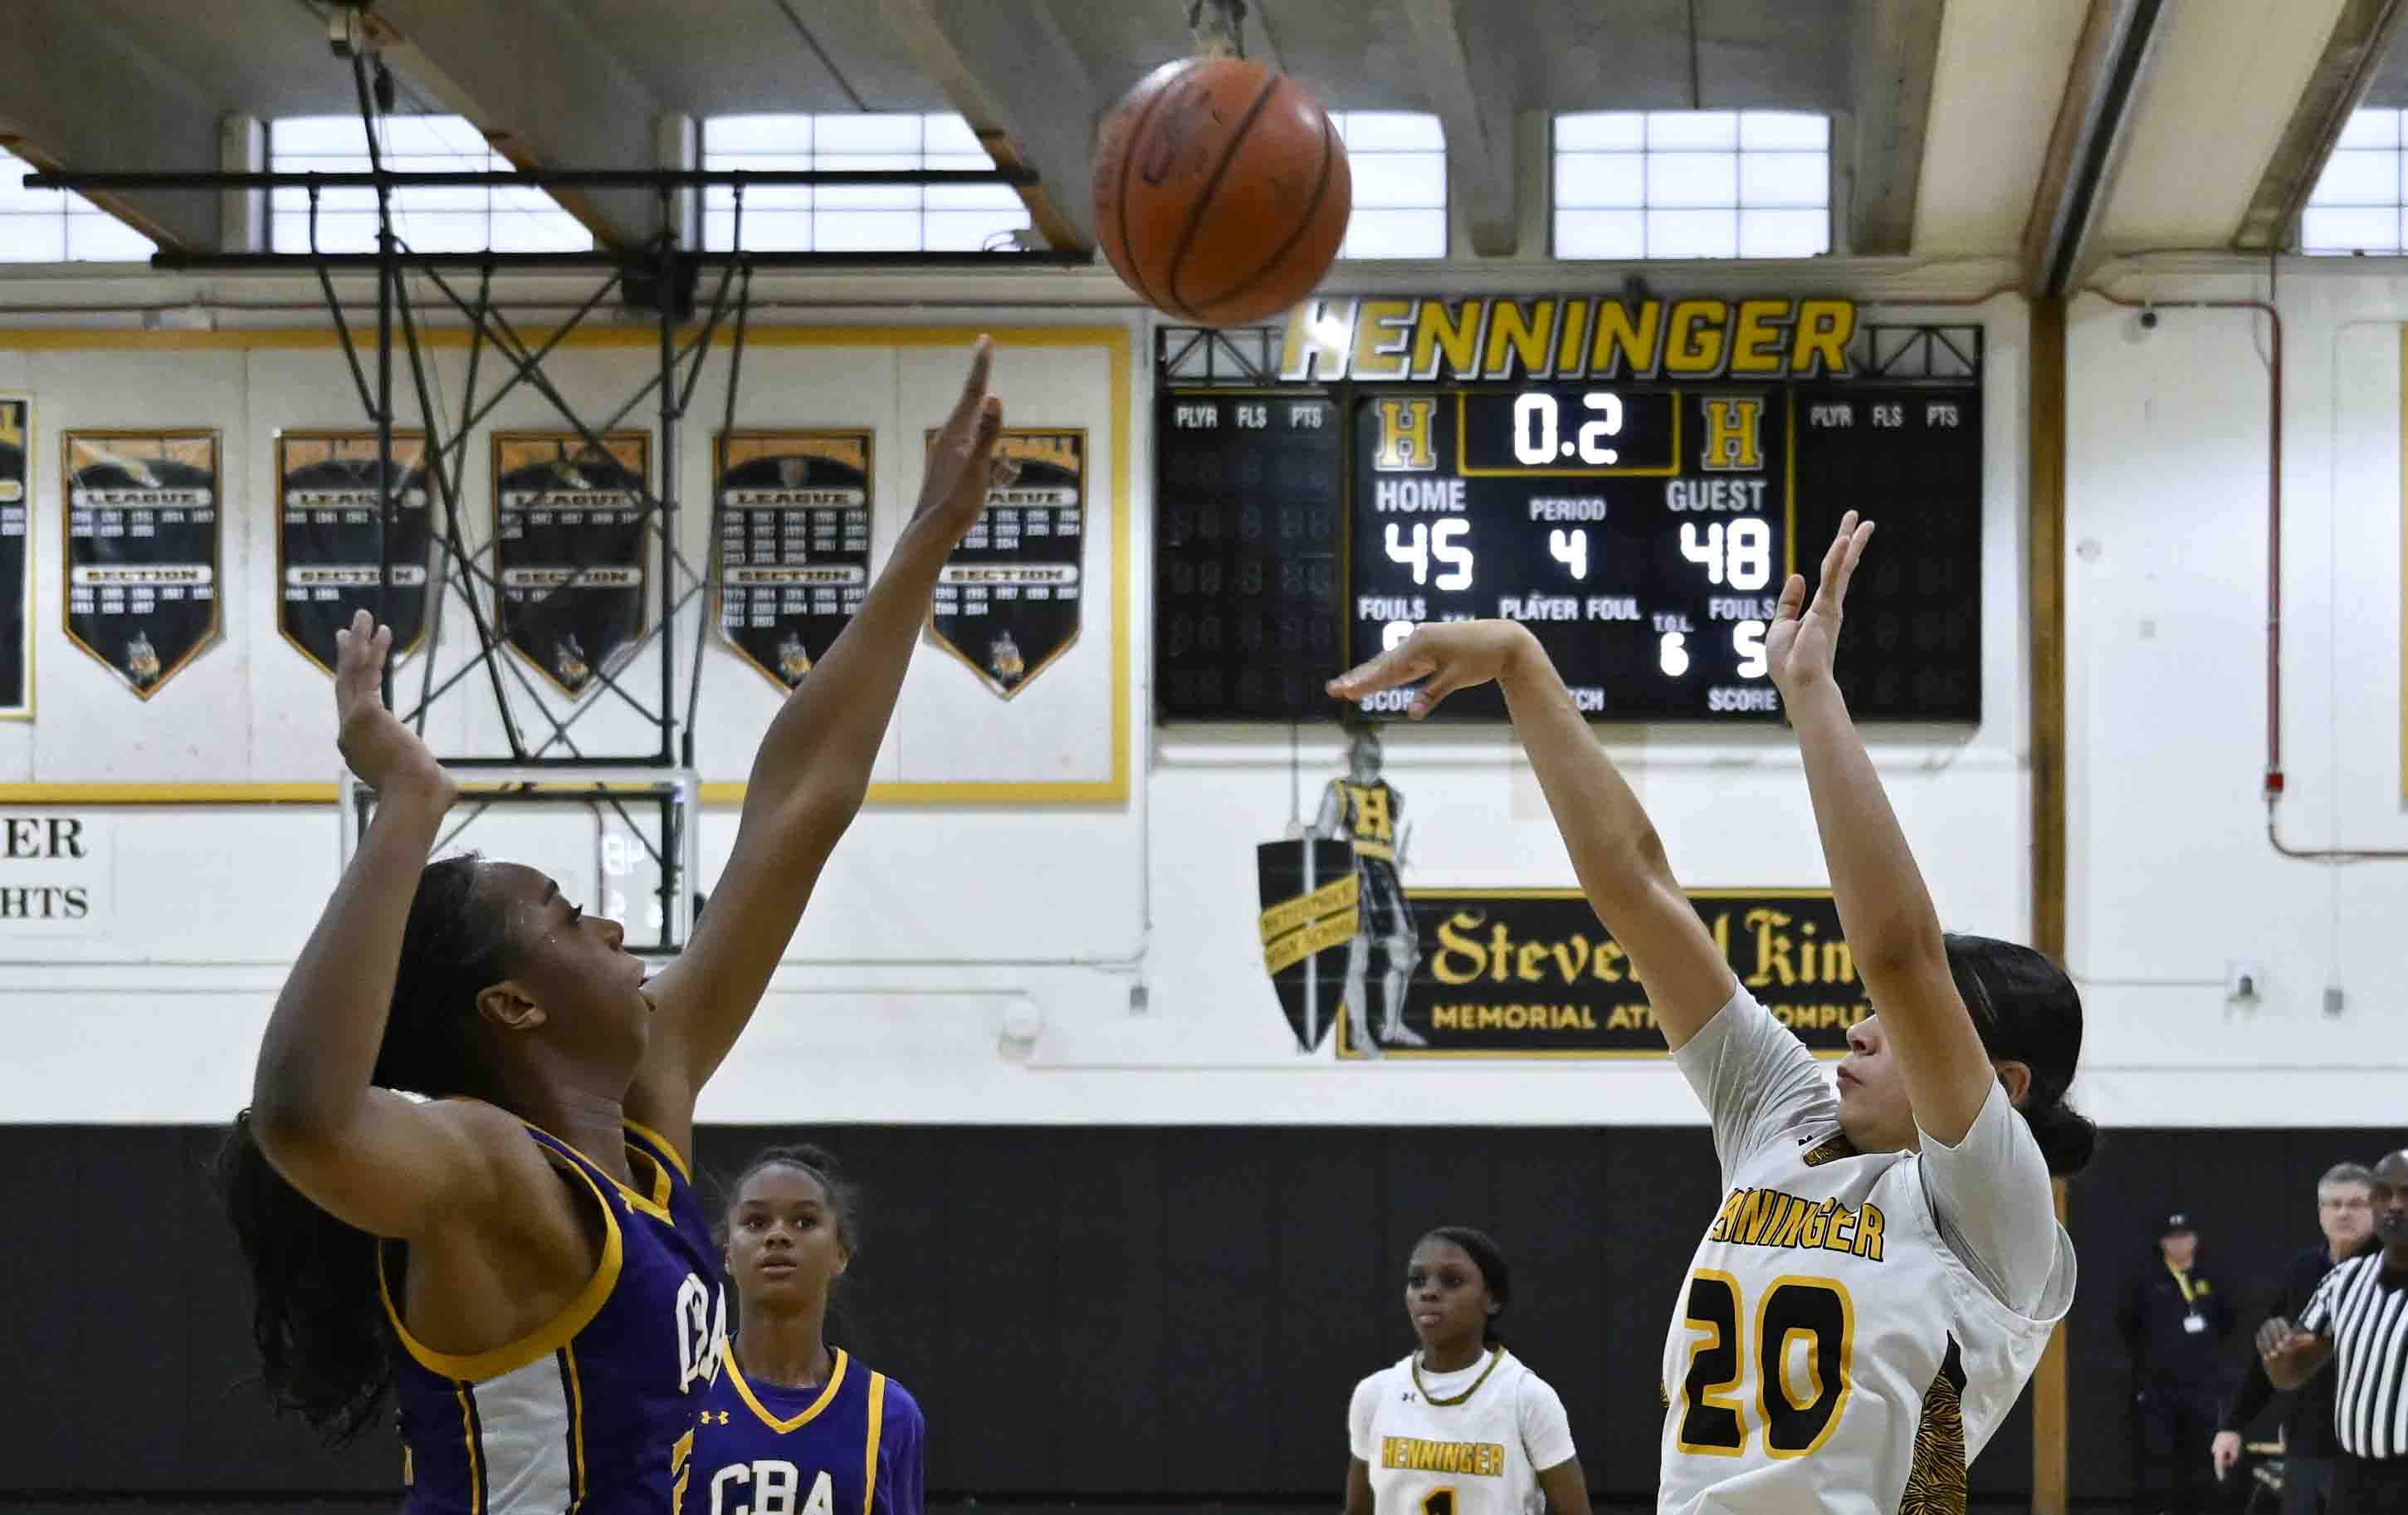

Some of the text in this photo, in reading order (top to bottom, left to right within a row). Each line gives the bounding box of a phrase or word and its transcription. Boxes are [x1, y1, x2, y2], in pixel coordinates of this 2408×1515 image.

[1279, 298, 1859, 380] HENNINGER
[1177, 405, 1322, 428] PLYR FLS PTS
[1375, 398, 1437, 471] H
[1514, 393, 1624, 465] 0.2
[1702, 398, 1762, 471] H
[1811, 405, 1959, 428] PLYR FLS PTS
[1375, 480, 1468, 512] HOME
[1529, 498, 1607, 521] PERIOD
[1666, 480, 1767, 511] GUEST
[1385, 518, 1473, 590] 45
[1549, 530, 1587, 580] 4
[1679, 518, 1771, 590] 48
[1358, 596, 1426, 620] FOULS
[1499, 595, 1641, 620] PLAYER FOUL
[1708, 596, 1775, 620] FOULS
[1660, 632, 1688, 677] 6
[1733, 620, 1767, 677] 5
[1707, 688, 1776, 711] SCORE
[2, 817, 88, 858] ER
[0, 887, 89, 918] HTS
[1432, 908, 1641, 985] Steve
[1744, 908, 1856, 986] Kin
[1432, 1004, 1596, 1030] MEMORIAL
[1676, 1268, 1854, 1460] 20
[1381, 1434, 1504, 1477] HENNINGER
[711, 1459, 833, 1515] CBA
